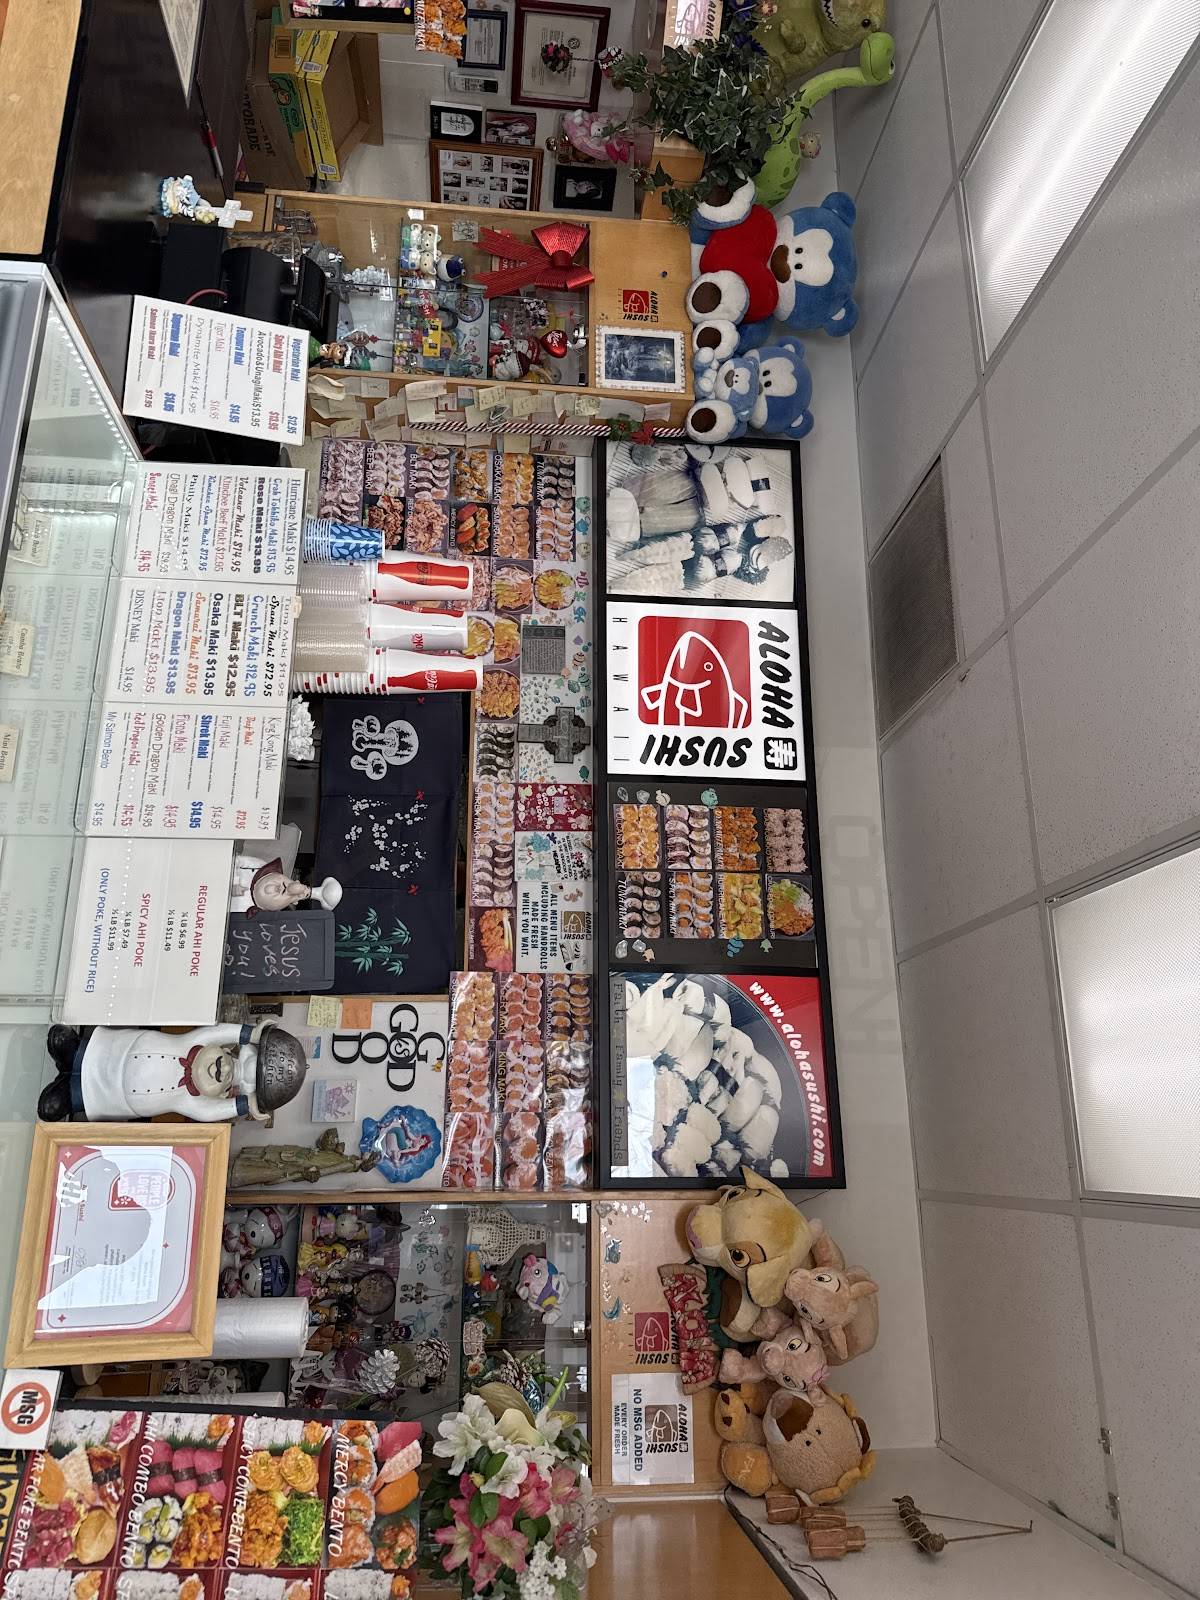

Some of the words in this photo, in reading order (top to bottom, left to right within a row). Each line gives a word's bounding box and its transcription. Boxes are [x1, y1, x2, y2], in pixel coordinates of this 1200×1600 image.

[705, 1, 717, 37] ALOHA
[623, 313, 649, 321] SUSHI
[273, 334, 285, 349] Spicy
[229, 404, 241, 423] $14.95
[268, 411, 279, 430] $13.95
[287, 416, 297, 434] $12.95
[366, 447, 375, 469] BEEF
[409, 453, 418, 469] BLT
[185, 474, 199, 503] Philly
[256, 477, 266, 504] Rose
[364, 469, 374, 489] MAKI
[408, 469, 417, 489] MAKI
[237, 476, 249, 513] Volcano
[288, 479, 301, 520] Hurricane
[183, 506, 193, 533] Maki
[233, 514, 247, 538] Maki
[255, 506, 264, 534] Maki
[286, 522, 298, 544] Maki
[231, 541, 243, 573] $14.95
[253, 536, 263, 574] $13.95
[284, 546, 296, 575] $14.95
[132, 589, 146, 622] DISNEY
[173, 591, 186, 628] Dragon
[192, 592, 206, 632] Samurai
[210, 593, 224, 626] Osaka
[233, 594, 245, 618] BLT
[249, 595, 264, 633] Crunch
[267, 595, 280, 627] Spam
[283, 596, 292, 625] Tuna
[129, 623, 142, 643] Maki
[170, 631, 182, 656] Maki
[207, 629, 220, 655] Maki
[229, 621, 242, 651] Maki
[266, 630, 277, 657] Maki
[280, 629, 289, 658] Maki
[189, 636, 202, 660] Maki
[246, 635, 259, 661] Maki
[122, 666, 135, 692] $14.95
[166, 659, 179, 694] $13.95
[186, 663, 198, 694] $13.95
[204, 659, 216, 696] $13.95
[225, 654, 239, 697] $12.95
[244, 664, 259, 697] $12.95
[263, 661, 275, 697] $12.95
[277, 662, 287, 697] $11.95
[758, 621, 794, 729] ALOHA
[102, 723, 116, 748] Salmon
[199, 715, 212, 738] Shrek
[150, 743, 163, 772] Dragon
[197, 740, 210, 759] Maki
[640, 734, 752, 768] SUSHI
[147, 775, 160, 795] Maki
[473, 786, 481, 815] SHREK
[92, 802, 105, 827] $14.95
[189, 801, 203, 829] $14.95
[99, 868, 110, 895] (ONLY
[618, 880, 627, 904] TUNA
[140, 893, 151, 920] SPICY
[195, 885, 208, 929] REGULAR
[540, 882, 548, 922] INCLUDING
[111, 916, 118, 925] LB
[124, 918, 131, 927] LB
[137, 921, 147, 939] AHI
[167, 917, 174, 926] LB
[181, 919, 188, 927] LB
[618, 905, 627, 930] MAKI
[669, 914, 677, 934] MAKI
[88, 925, 102, 968] WITHOUT
[108, 926, 117, 951] $11.99
[122, 929, 131, 949] $7.49
[164, 927, 174, 951] $11.49
[178, 929, 187, 949] $6.99
[193, 931, 203, 948] AHI
[280, 923, 308, 977] Jesus
[521, 937, 529, 958] WAIT.
[540, 925, 548, 970] HANDROLLS
[134, 941, 145, 967] POKE
[189, 951, 201, 977] POKE
[232, 930, 255, 978] you!
[85, 970, 97, 993] RICE)
[613, 983, 628, 1024] Faith
[498, 1010, 508, 1035] MAKI
[279, 1052, 286, 1063] to
[498, 1051, 506, 1076] KING
[612, 1045, 625, 1086] Family
[275, 1066, 285, 1083] my
[749, 982, 827, 1166] www.alohasushi.com
[497, 1077, 506, 1103] MAKI
[613, 1106, 625, 1159] Friends
[545, 1151, 554, 1182] BENTO
[635, 1353, 670, 1364] SUSHI
[17, 1391, 39, 1425] MSG
[633, 1389, 642, 1405] NO
[144, 1415, 158, 1442] AHI
[634, 1408, 642, 1431] MSG
[678, 1403, 688, 1441] ALOHA
[634, 1435, 643, 1471] ADDED
[646, 1443, 678, 1453] SUSHI
[131, 1444, 153, 1507] COMBO
[333, 1433, 350, 1494] MERCY
[20, 1474, 41, 1516] POKE
[235, 1466, 252, 1509] CONE
[120, 1510, 143, 1569] BENTO
[328, 1496, 345, 1557] BENTO
[8, 1518, 32, 1569] BENTO
[225, 1512, 245, 1569] BENTO
